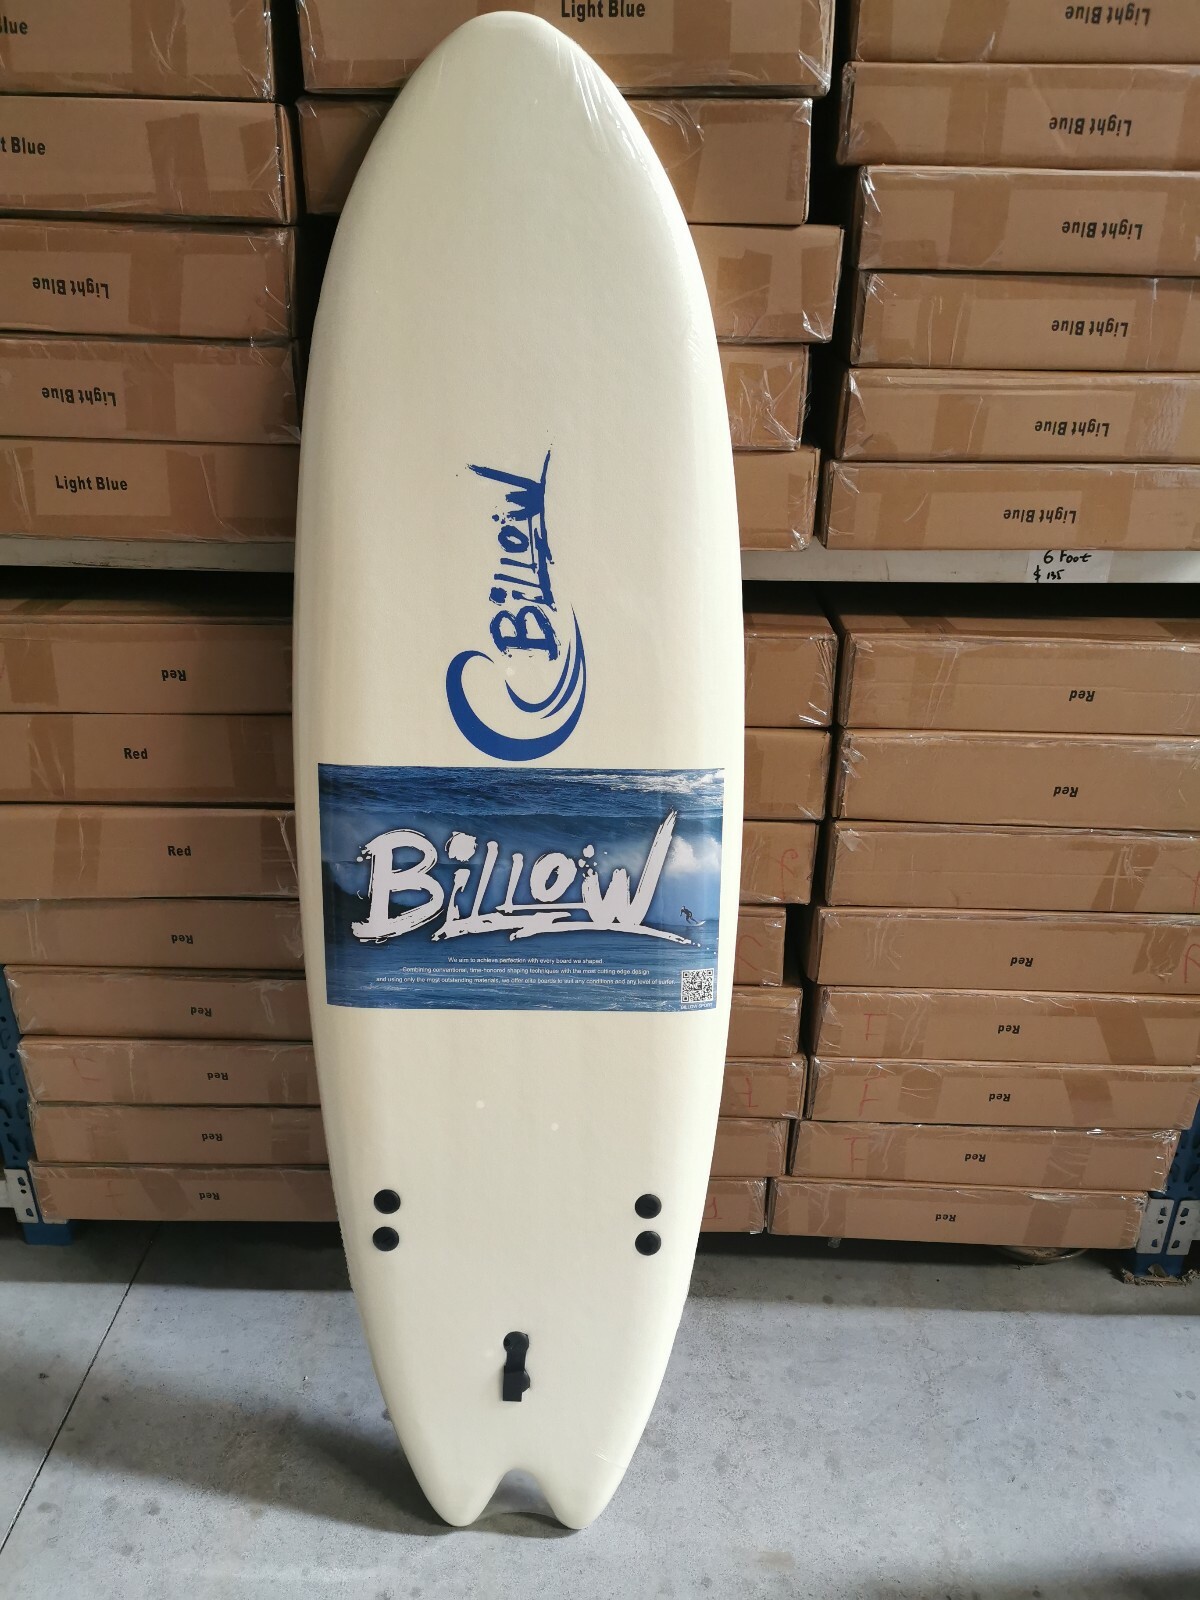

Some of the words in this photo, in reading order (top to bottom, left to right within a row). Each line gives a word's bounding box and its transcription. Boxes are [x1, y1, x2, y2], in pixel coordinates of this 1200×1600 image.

[561, 0, 604, 23] Light
[608, 0, 646, 18] Blue
[1064, 5, 1103, 25] Blue
[1106, 2, 1151, 26] Light
[0, 15, 28, 35] lue
[1048, 116, 1086, 136] Blue
[1089, 114, 1132, 137] Light
[10, 136, 46, 156] Blue
[1061, 221, 1098, 239] Blue
[1101, 218, 1143, 241] Light
[32, 277, 67, 296] Blue
[69, 277, 110, 300] Light
[1051, 319, 1086, 336] Blue
[1088, 317, 1129, 338] Light
[41, 387, 75, 404] Blue
[77, 386, 117, 407] Light
[1034, 420, 1068, 436] Blue
[1071, 418, 1110, 438] Light
[54, 475, 93, 494] Light
[95, 476, 128, 491] Blue
[1003, 509, 1036, 523] Blue
[1038, 506, 1077, 524] Light
[1043, 550, 1054, 564] 6
[161, 669, 187, 682] Red
[1068, 689, 1096, 703] Red
[123, 747, 148, 760] Red
[1052, 786, 1079, 798] Red
[167, 845, 192, 857] Red
[170, 934, 194, 945] Red
[1009, 956, 1034, 968] Red
[190, 1006, 212, 1018] Red
[997, 1024, 1021, 1035] Red
[206, 1072, 229, 1081] Red
[988, 1093, 1011, 1102] Red
[201, 1133, 223, 1142] Red
[964, 1153, 987, 1163] Red
[198, 1192, 221, 1201] Red
[935, 1213, 957, 1222] Red
